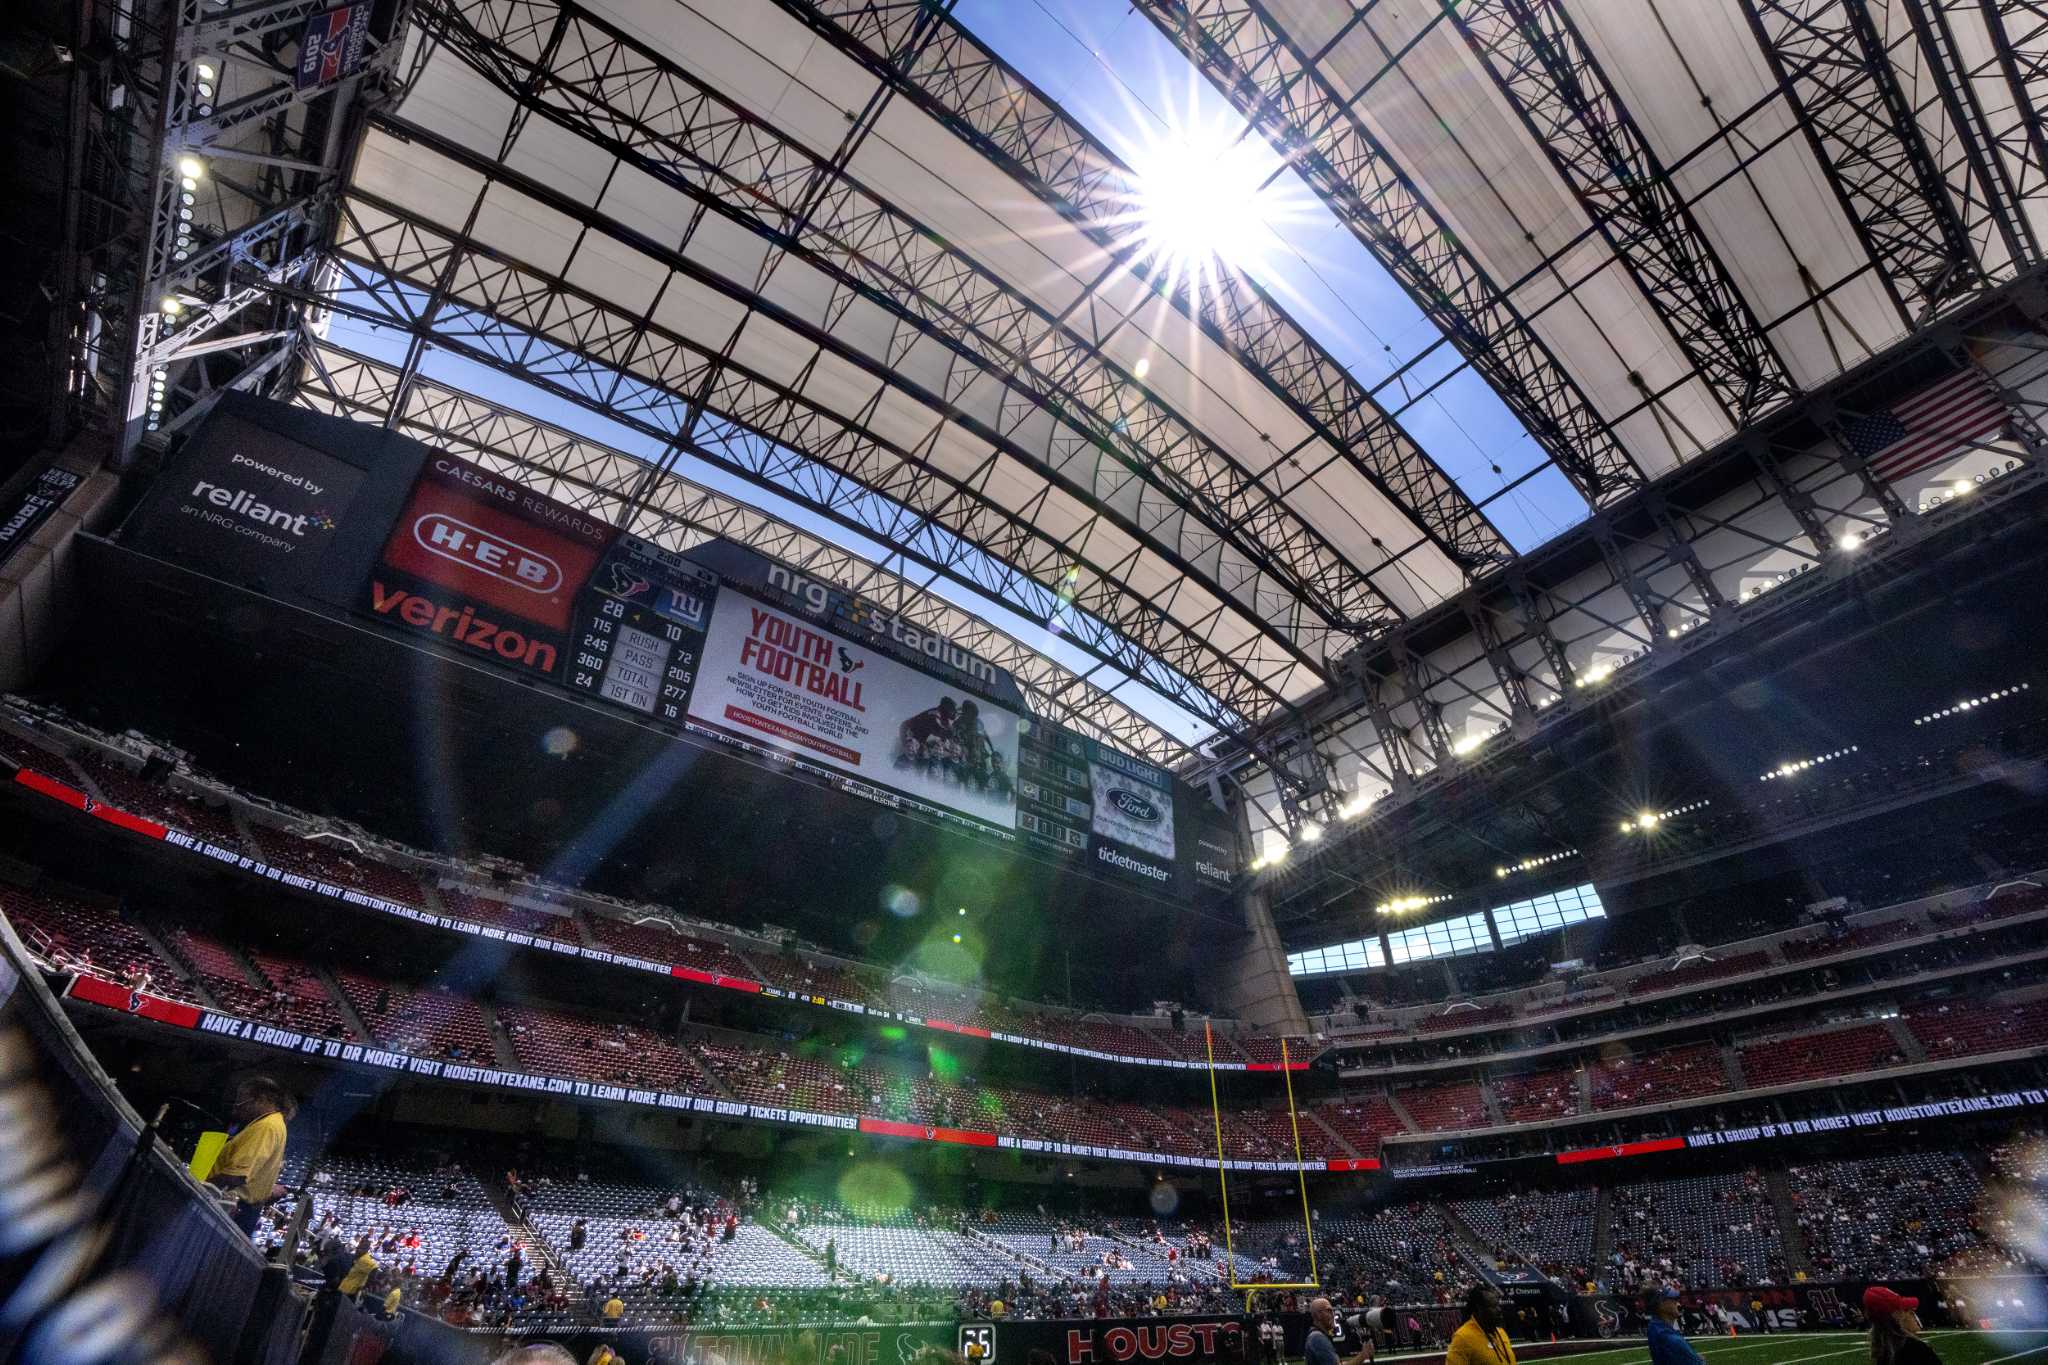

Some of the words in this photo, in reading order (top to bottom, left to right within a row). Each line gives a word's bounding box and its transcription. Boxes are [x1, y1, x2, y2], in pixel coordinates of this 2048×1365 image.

[303, 33, 322, 74] 2019
[232, 454, 303, 487] powered
[304, 479, 325, 495] by
[24, 493, 55, 509] TEXT
[191, 480, 309, 537] reliant
[434, 459, 517, 503] CAESARS
[522, 496, 604, 541] REWARDS
[180, 504, 198, 517] an
[199, 510, 234, 530] NRG
[234, 524, 297, 553] company
[371, 580, 557, 673] verizon
[592, 616, 613, 635] 115
[630, 631, 660, 653] RUSH
[677, 649, 693, 665] 72
[602, 599, 625, 620] 28
[665, 623, 682, 642] 10
[750, 607, 833, 667] YOUTH
[767, 563, 829, 614] nrg
[868, 609, 998, 685] stadium
[576, 652, 604, 671] 360
[617, 665, 650, 689] TOTAL
[663, 684, 687, 701] 277
[584, 634, 609, 653] 245
[625, 649, 654, 669] PASS
[668, 665, 692, 684] 205
[740, 636, 866, 712] FOOTBALL
[575, 671, 593, 689] 24
[611, 684, 630, 700] 1ST
[631, 691, 648, 708] DN
[664, 703, 678, 719] 16
[726, 675, 778, 700] NEWSLETTER
[777, 694, 795, 707] FOR
[854, 723, 869, 735] AND
[735, 686, 756, 699] HOW
[755, 693, 767, 703] TO
[767, 698, 783, 710] GET
[783, 702, 801, 716] KIDS
[801, 708, 838, 730] INVOLVED
[836, 722, 846, 732] IN
[845, 725, 860, 739] THE
[737, 671, 756, 684] SIGN
[756, 679, 768, 688] UP
[767, 684, 784, 696] FOR
[784, 689, 801, 701] OUR
[801, 696, 827, 711] YOUTH
[826, 704, 862, 724] FOOTBALL
[751, 699, 778, 715] YOUTH
[778, 708, 816, 730] FOOTBALL
[817, 725, 844, 740] WORLD
[1099, 748, 1126, 769] BUD
[1125, 761, 1160, 782] LIGHT
[1116, 790, 1150, 819] Ford
[1097, 845, 1169, 881] ticketmaster
[1195, 860, 1232, 883] reliant
[165, 831, 193, 850] HAVE
[193, 842, 202, 853] A
[203, 843, 240, 865] GROUP
[239, 858, 254, 870] OF
[254, 862, 267, 876] 10
[266, 868, 281, 881] OR
[281, 872, 316, 892] MORE?
[316, 882, 344, 899] VISIT
[343, 891, 438, 927] HOUSTONTEXANS.COM
[439, 917, 452, 930] TO
[452, 920, 481, 935] LEARN
[481, 926, 505, 941] MORE
[506, 931, 534, 946] ABOUT
[534, 937, 552, 951] OUR
[552, 941, 579, 956] GROUP
[579, 946, 613, 963] TICKETS
[613, 953, 672, 976] OPPORTUNITIES!
[200, 1013, 239, 1035] HAVE
[240, 1022, 253, 1039] A
[253, 1026, 302, 1049] GROUP
[301, 1037, 322, 1053] OF
[323, 1039, 341, 1057] 10
[341, 1044, 362, 1062] OR
[363, 1048, 409, 1069] MORE?
[409, 1057, 443, 1076] VISIT
[443, 1066, 573, 1093] HOUSTONTEXANS.COM
[574, 1082, 589, 1097] TO
[591, 1084, 626, 1100] LEARN
[627, 1090, 657, 1105] MORE
[658, 1095, 693, 1109] ABOUT
[693, 1098, 714, 1112] OUR
[715, 1101, 748, 1117] GROUP
[749, 1105, 787, 1122] TICKETS
[788, 1110, 858, 1130] OPPORTUNITIES!
[1119, 1055, 1134, 1064] LEARN
[1148, 1058, 1163, 1066] ABOUT
[1188, 1061, 1208, 1069] TICKETS
[1687, 1133, 1714, 1148] HAVE
[1715, 1132, 1725, 1144] A
[1725, 1129, 1761, 1143] GROUP
[1761, 1125, 1777, 1137] OF
[1777, 1123, 1793, 1136] 10
[1793, 1121, 1811, 1134] OR
[1811, 1116, 1851, 1131] MORE?
[1850, 1111, 1884, 1126] VISIT
[1883, 1092, 2025, 1122] HOUSTONTEXANS.COM
[2022, 1089, 2045, 1105] TO
[998, 1136, 1015, 1148] HAVE
[1015, 1139, 1022, 1149] A
[1022, 1140, 1043, 1151] GROUP
[1044, 1142, 1054, 1152] OF
[1054, 1143, 1061, 1153] 10
[1062, 1144, 1072, 1154] OR
[1072, 1145, 1092, 1156] MORE?
[1092, 1147, 1108, 1158] VISIT
[1108, 1149, 1166, 1164] HOUSTONTEXANS.COM
[1166, 1154, 1173, 1165] TO
[1174, 1155, 1190, 1166] LEARN
[1191, 1157, 1204, 1168] MORE
[1204, 1159, 1220, 1169] ABOUT
[1234, 1160, 1253, 1170] GROUP
[1253, 1161, 1277, 1171] TICKETS
